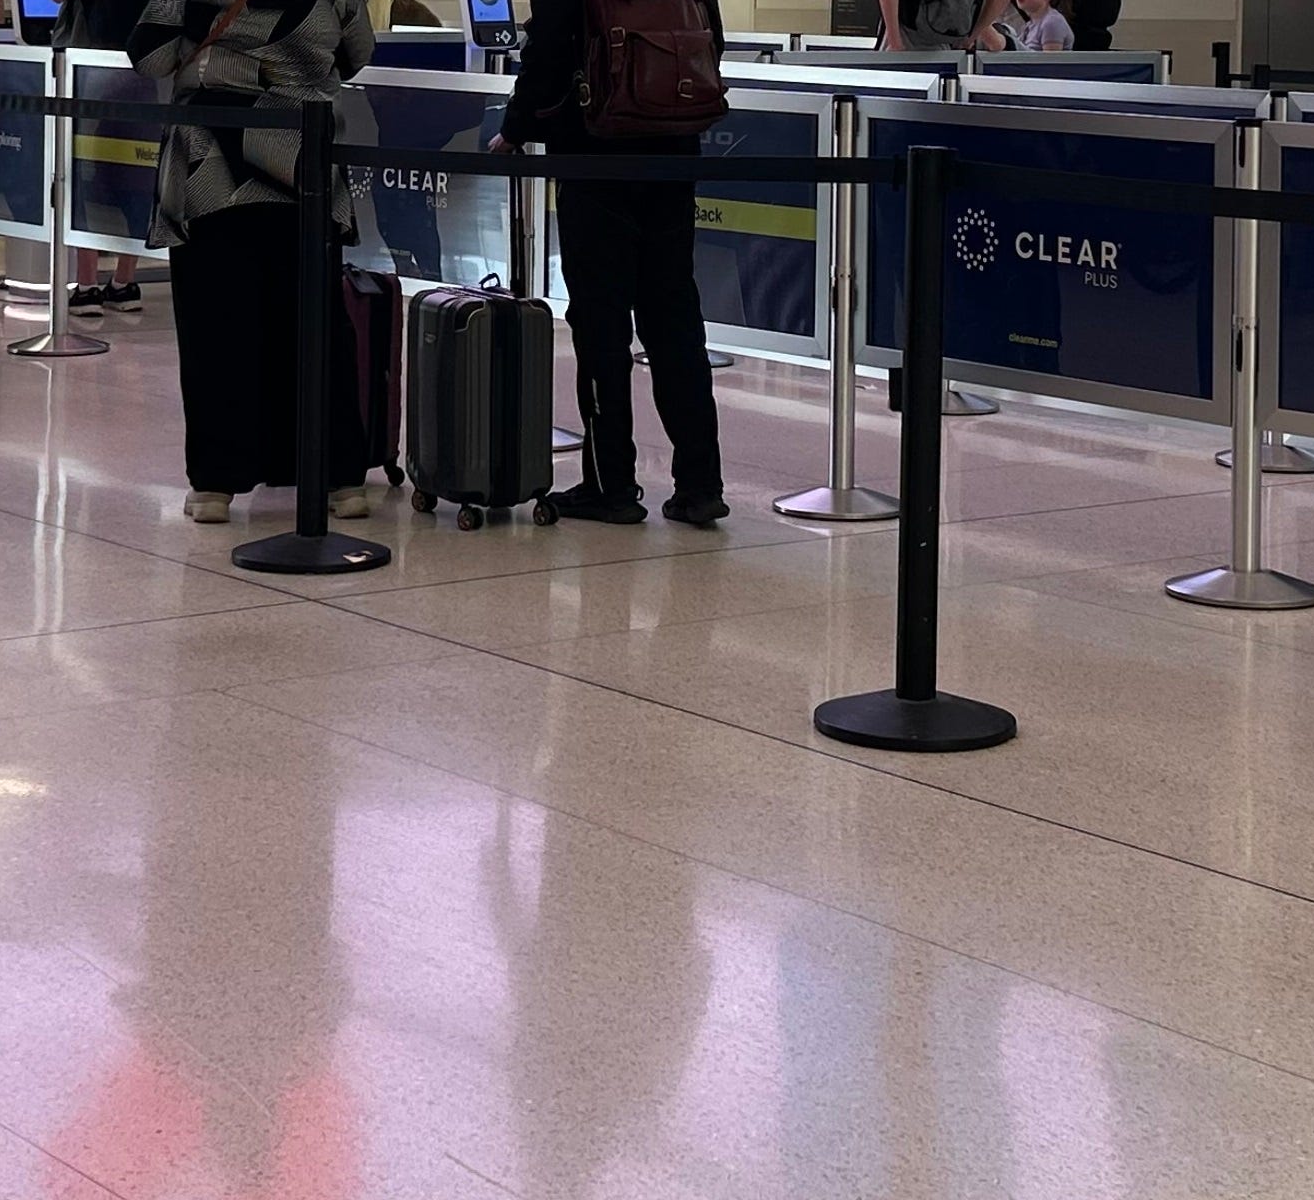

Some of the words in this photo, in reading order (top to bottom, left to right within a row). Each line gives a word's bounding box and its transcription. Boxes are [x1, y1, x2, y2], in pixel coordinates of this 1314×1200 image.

[382, 167, 448, 194] CLEAR
[426, 196, 448, 209] PLUS
[1015, 231, 1118, 270] CLEAR
[1084, 271, 1118, 289] PLUS
[1008, 332, 1058, 348] clearme.com
